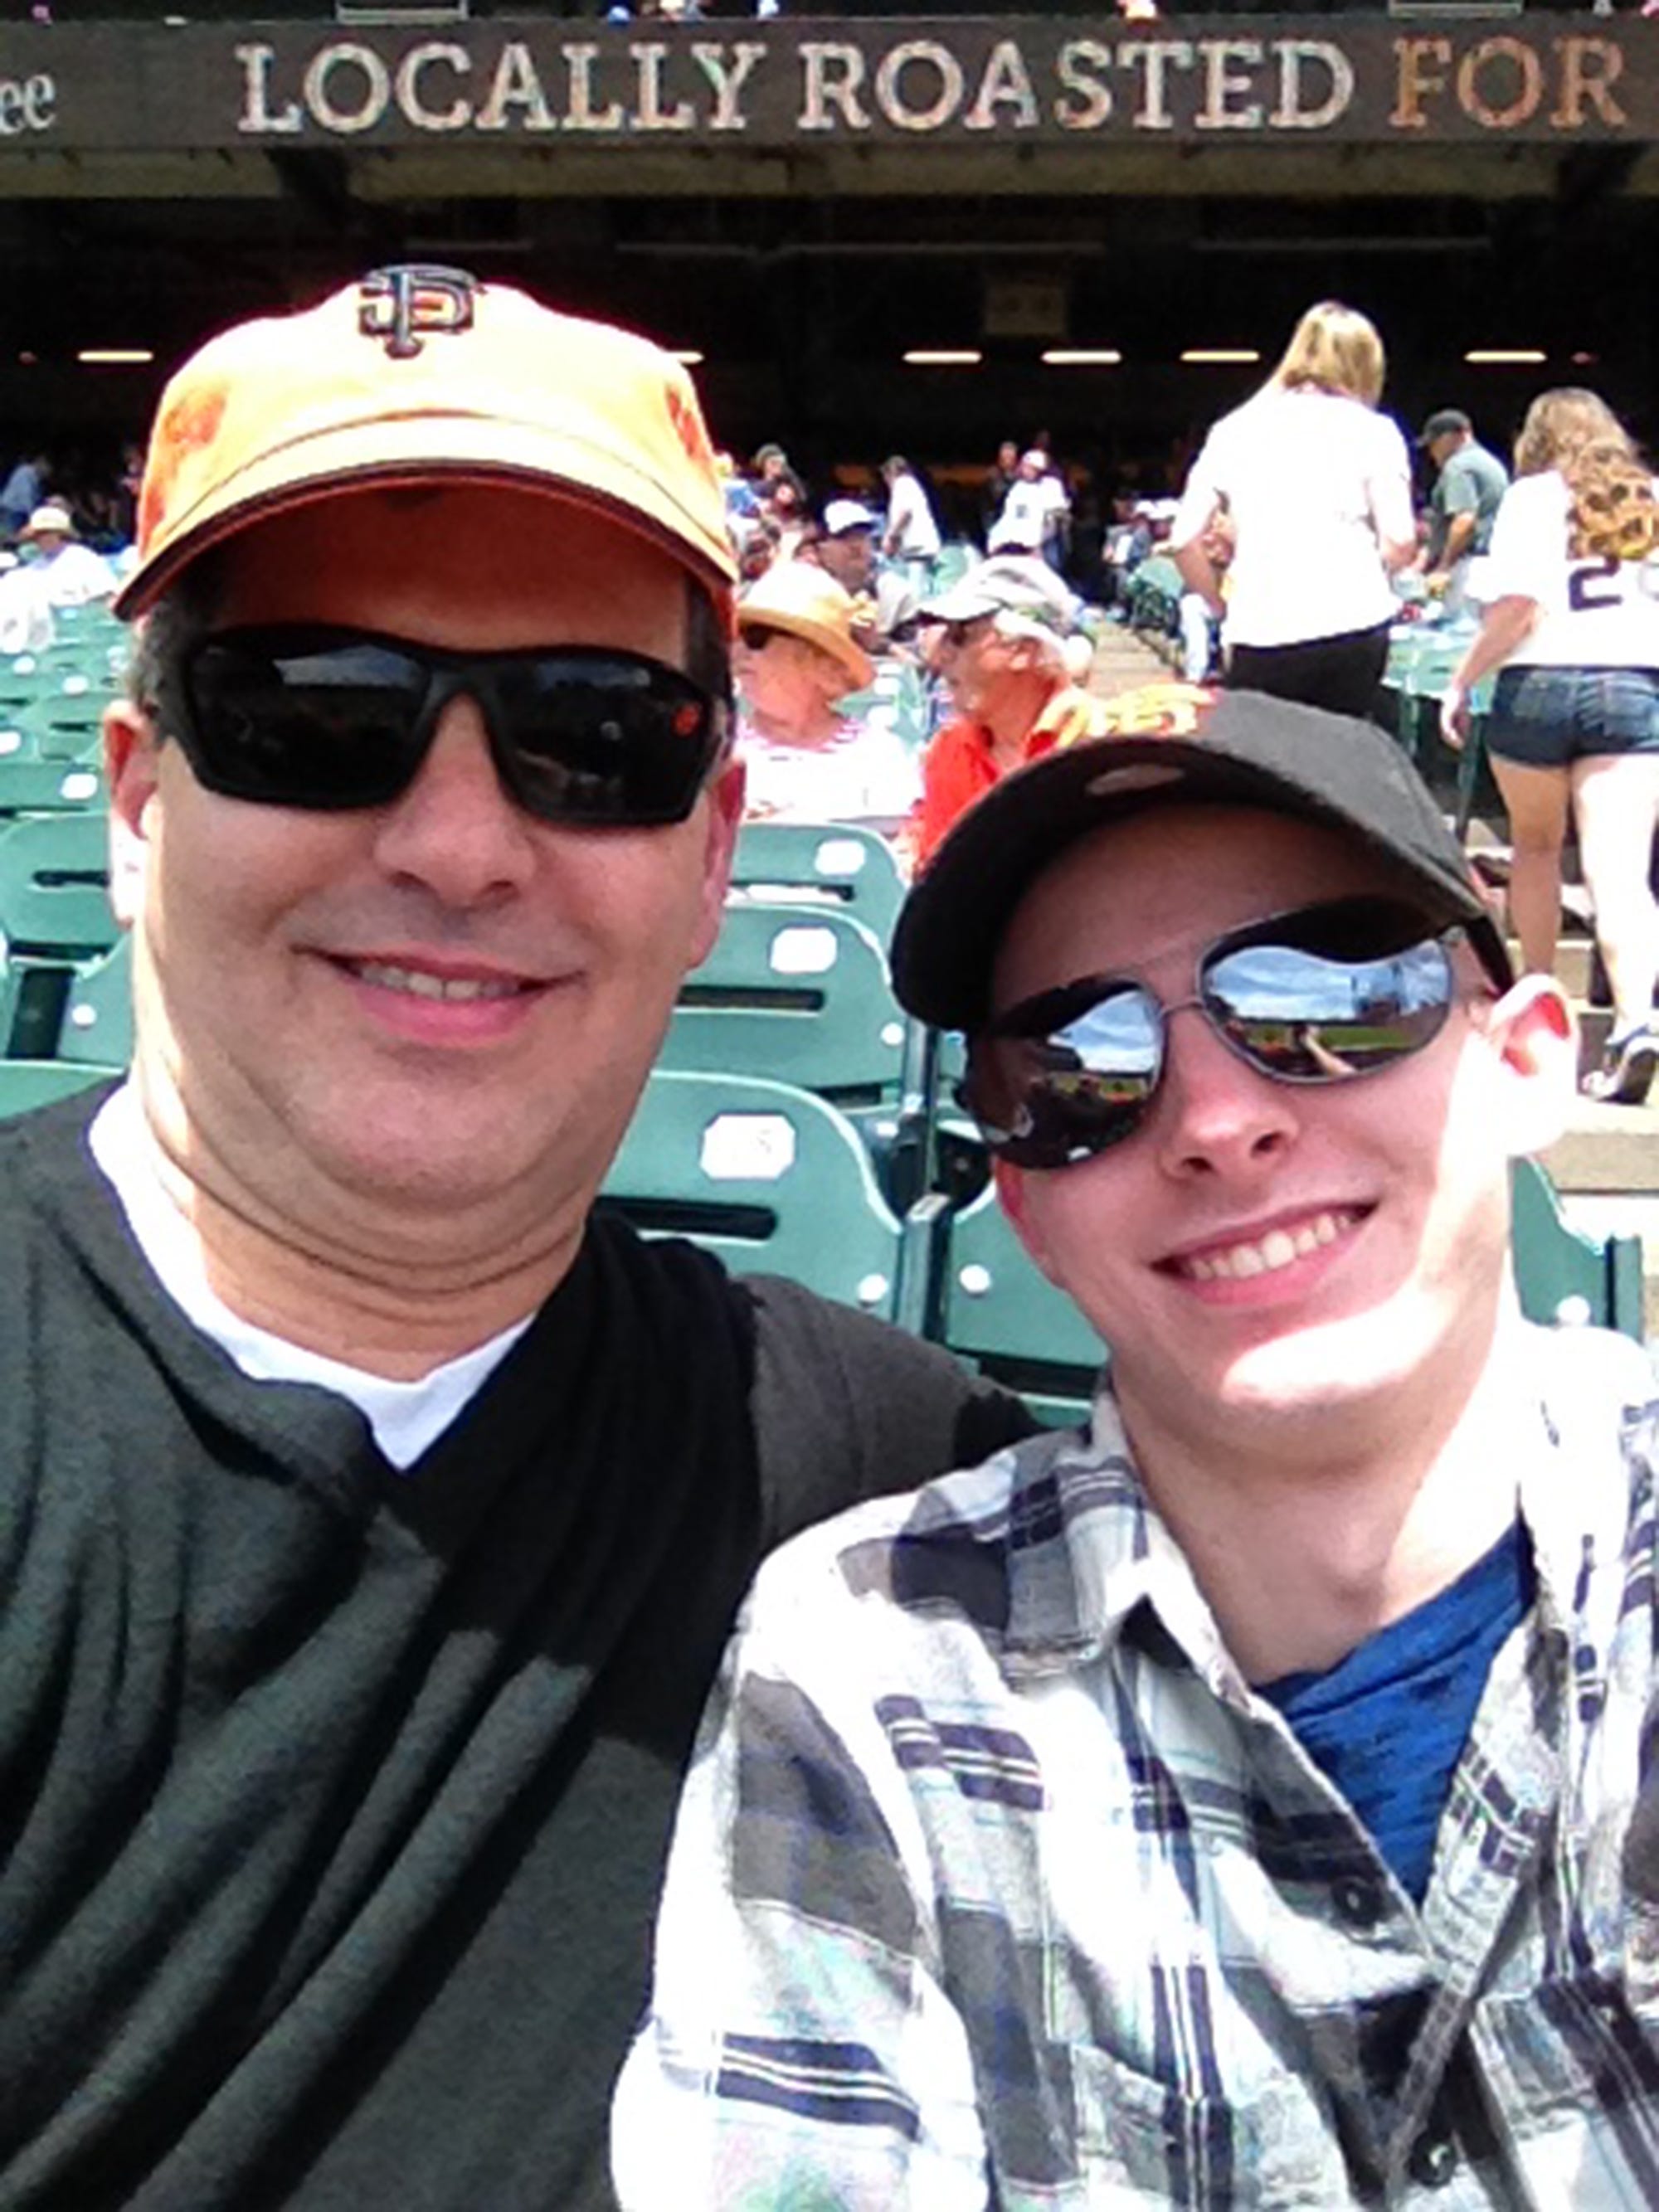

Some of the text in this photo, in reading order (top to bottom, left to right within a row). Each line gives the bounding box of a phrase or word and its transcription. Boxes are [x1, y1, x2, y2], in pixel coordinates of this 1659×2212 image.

[235, 36, 1627, 132] LOCALLY ROASTED FOR
